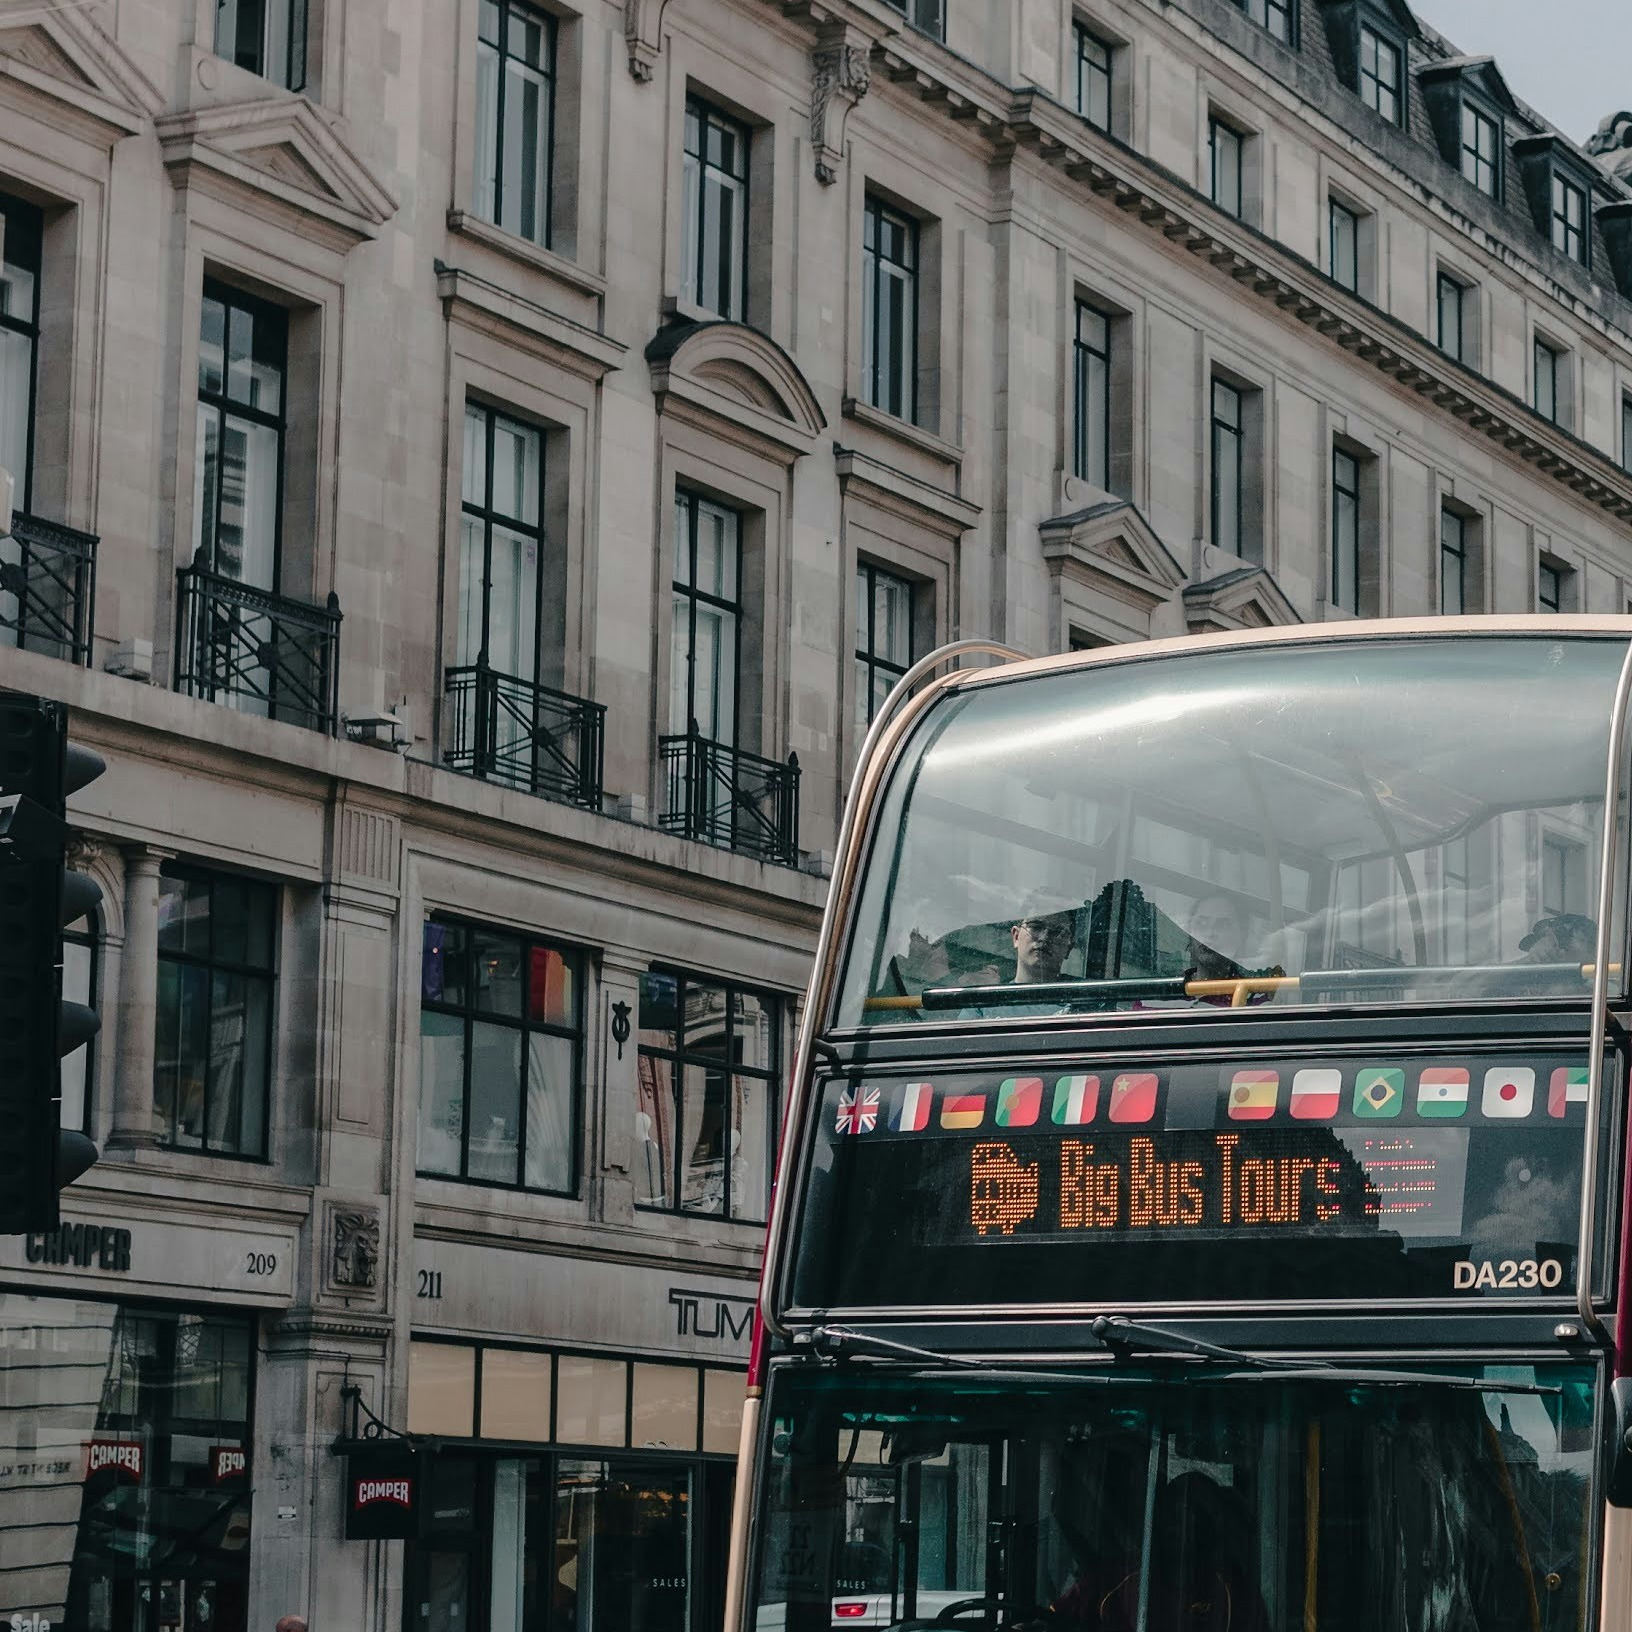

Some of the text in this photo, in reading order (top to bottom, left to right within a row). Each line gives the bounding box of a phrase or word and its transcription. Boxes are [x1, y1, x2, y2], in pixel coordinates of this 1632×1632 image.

[1061, 1140, 1118, 1227] Big
[1130, 1138, 1203, 1226] Bus
[1206, 1135, 1340, 1224] Tours
[26, 1222, 131, 1271] CAMPER
[246, 1253, 276, 1275] 209
[1453, 1259, 1562, 1289] DA230
[417, 1269, 443, 1298] 211
[669, 1288, 757, 1341] TUM
[91, 1445, 140, 1473] CAMPER
[359, 1482, 409, 1503] CAMPER
[653, 1578, 686, 1587] SALES
[836, 1579, 866, 1590] SALES
